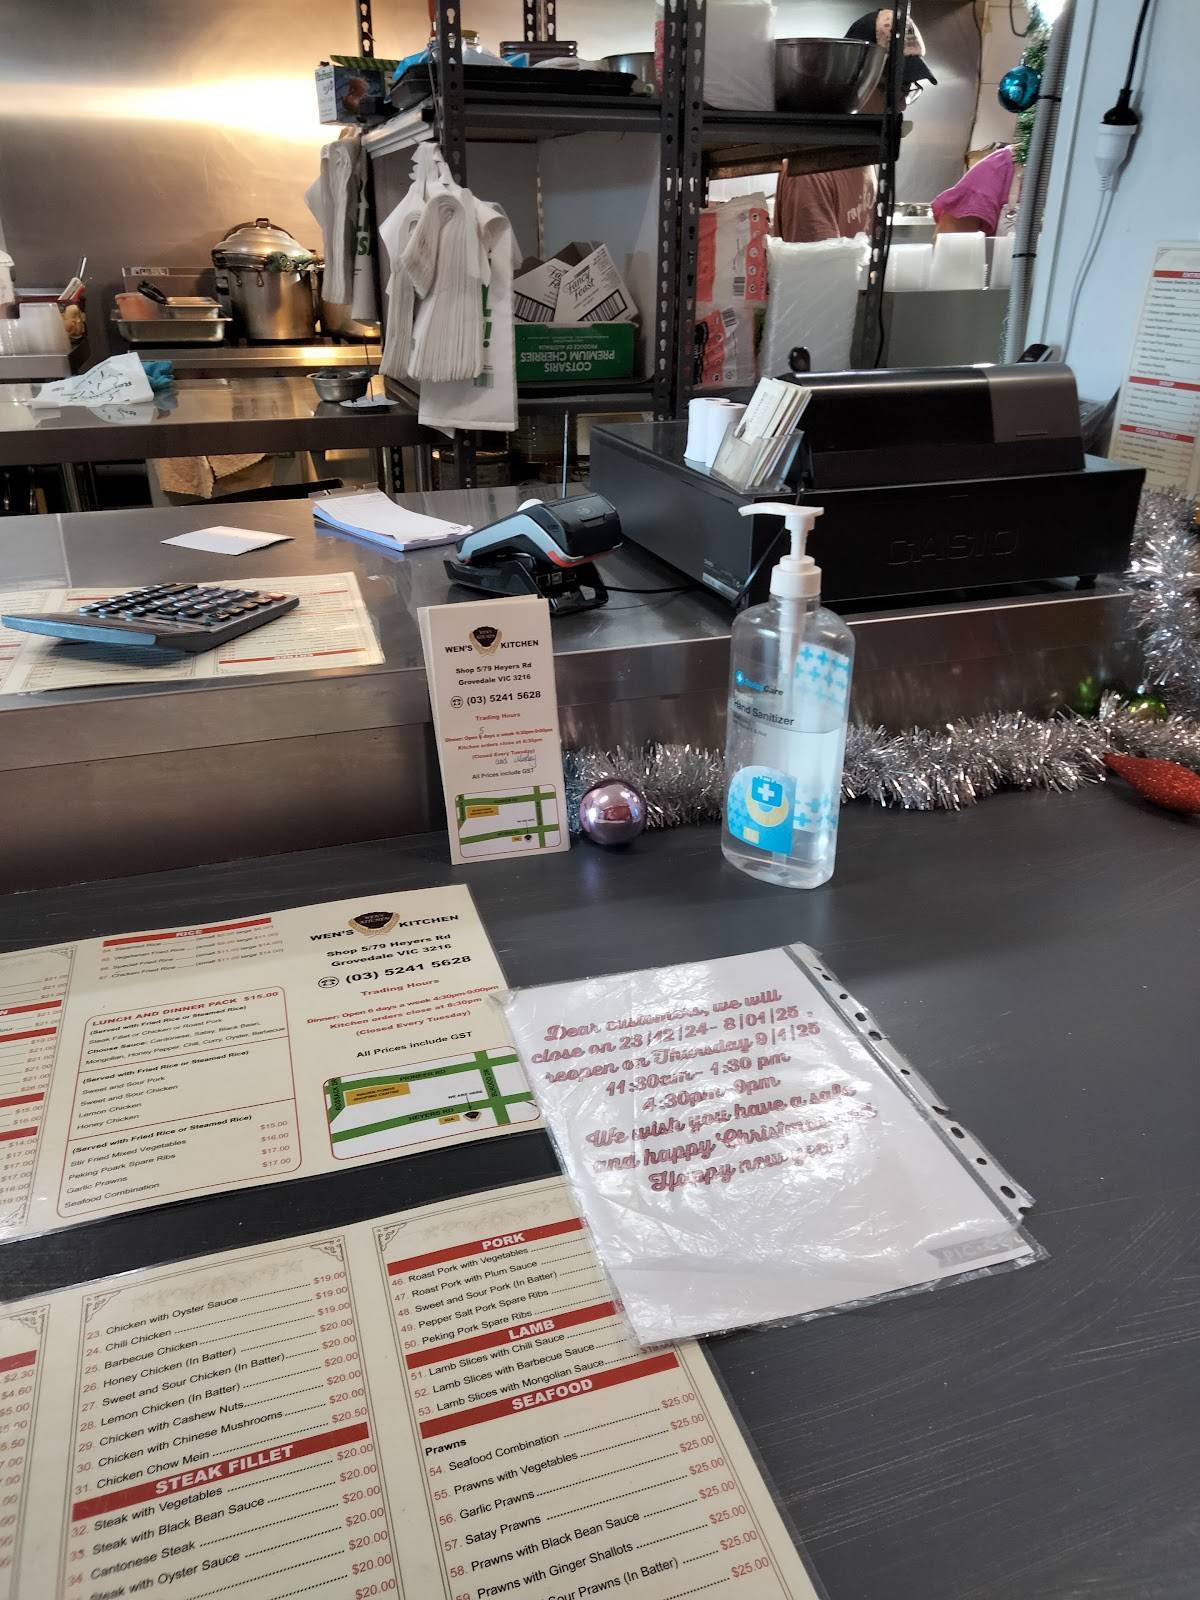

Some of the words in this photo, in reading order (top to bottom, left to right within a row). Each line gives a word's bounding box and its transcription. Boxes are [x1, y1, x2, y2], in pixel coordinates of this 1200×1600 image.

[520, 351, 567, 362] CHERRIES
[570, 350, 615, 361] PREMIUM
[888, 529, 1021, 566] CASIO
[445, 644, 473, 653] WEN'S
[501, 639, 539, 649] KITCHEN
[455, 666, 474, 674] Shop
[494, 663, 520, 672] Heyers
[458, 677, 496, 686] Grovedale
[513, 673, 531, 681] 3216
[467, 695, 487, 706] (03)
[489, 692, 513, 702] 5241
[517, 690, 541, 700] 5628
[752, 708, 795, 726] Sanitizer
[481, 771, 499, 779] Prices
[522, 767, 534, 775] GST
[310, 930, 354, 941] WEN'S
[399, 915, 459, 928] KITCHEN
[326, 948, 357, 957] Shop
[361, 943, 386, 952] 5/79
[390, 937, 432, 947] Heyers
[331, 953, 394, 967] Grovedale
[397, 948, 419, 956] VIC
[422, 943, 452, 953] 3216
[346, 971, 379, 984] (03)
[384, 963, 424, 976] 5241
[431, 955, 472, 968] 5628
[360, 985, 403, 997] Trading
[406, 979, 440, 988] Hours
[92, 1014, 132, 1027] LUNCH
[135, 1010, 160, 1020] AND
[162, 1003, 205, 1015] DINNER
[208, 998, 238, 1008] PACK
[243, 991, 279, 1001] $15.00
[330, 1019, 369, 1029] Kitchen
[371, 1013, 403, 1022] orders
[406, 1008, 432, 1016] close
[447, 997, 482, 1009] 8:30pm
[342, 1011, 366, 1019] Open
[376, 1004, 397, 1013] days
[407, 999, 431, 1007] week
[544, 1022, 600, 1042] Dear
[712, 1000, 742, 1013] we
[744, 989, 782, 1005] will
[356, 1026, 393, 1036] (Closed
[397, 1019, 424, 1029] Every
[427, 1009, 471, 1023] Tuesday)
[356, 1050, 371, 1058] All
[374, 1043, 407, 1055] Prices
[410, 1036, 448, 1048] include
[450, 1031, 472, 1040] GST
[531, 1046, 586, 1065] close
[589, 1041, 616, 1055] on
[546, 1062, 619, 1083] reopen
[622, 1057, 650, 1071] on
[757, 1052, 791, 1071] pm
[586, 1128, 629, 1148] We
[735, 1098, 788, 1119] have
[790, 1095, 806, 1108] a
[643, 1139, 717, 1166] happy
[68, 1169, 98, 1181] Peking
[129, 1157, 154, 1168] Spare
[156, 1153, 176, 1162] Ribs
[481, 1232, 526, 1250] PORK
[408, 1271, 435, 1283] Roast
[437, 1264, 459, 1275] Pork
[460, 1259, 478, 1269] with
[481, 1248, 529, 1265] Vegetables
[106, 1320, 147, 1335] Chicken
[150, 1313, 169, 1324] with
[172, 1304, 204, 1318] Oyster
[207, 1296, 239, 1309] Sauce
[313, 1271, 346, 1285] $19.00
[509, 1319, 555, 1340] LAMB
[103, 1373, 138, 1388] Honey
[140, 1362, 182, 1378] Chicken
[185, 1355, 199, 1367] (In
[202, 1347, 236, 1361] Batter)
[320, 1318, 353, 1332] $20.00
[512, 1379, 593, 1410] SEAFOOD
[448, 1451, 493, 1471] Seafood
[495, 1432, 560, 1457] Combination
[661, 1393, 695, 1409] $25.00
[425, 1439, 467, 1456] Prawns
[454, 1476, 495, 1495] Prawns
[496, 1469, 518, 1482] with
[520, 1451, 579, 1473] Vegetables
[670, 1413, 705, 1430] $25.00
[155, 1464, 222, 1494] STEAK
[229, 1445, 293, 1474] FILLET
[465, 1527, 498, 1545] Satay
[500, 1515, 541, 1535] Prawns
[689, 1457, 725, 1475] $25.00
[471, 1552, 514, 1572] Prawns
[516, 1543, 539, 1557] with
[541, 1532, 572, 1550] Black
[574, 1525, 603, 1539] Bean
[605, 1511, 640, 1530] Sauce
[699, 1480, 735, 1499] $25.00
